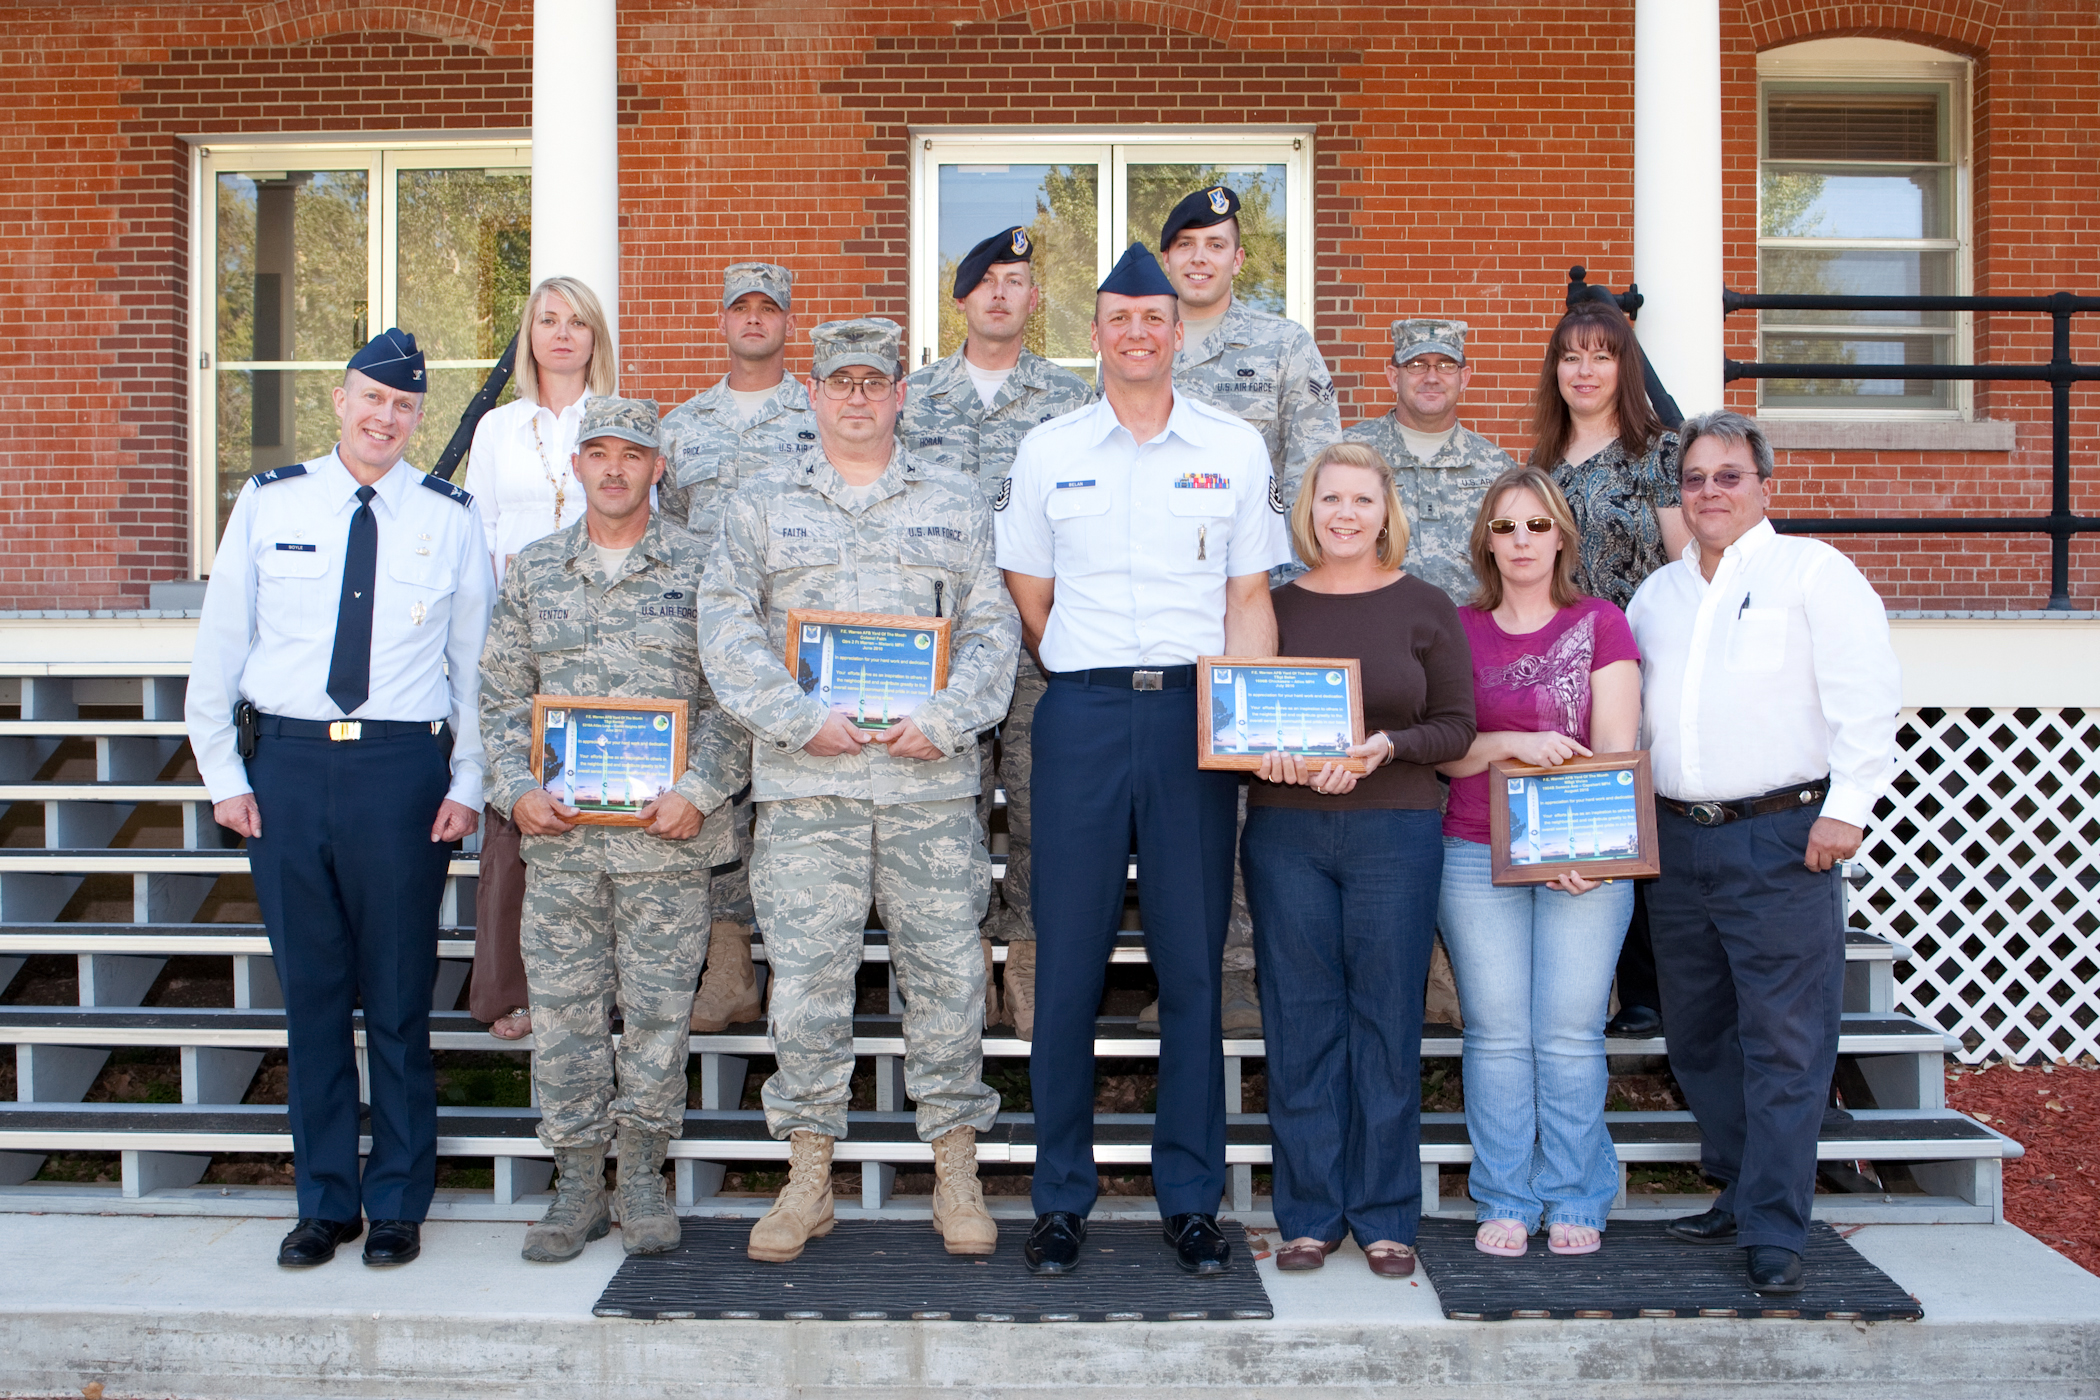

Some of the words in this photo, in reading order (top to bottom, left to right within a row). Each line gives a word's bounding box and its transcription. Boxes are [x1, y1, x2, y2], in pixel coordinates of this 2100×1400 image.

[1217, 382, 1232, 392] U.S.
[1234, 382, 1247, 392] AIR
[1249, 382, 1273, 392] FORCE
[779, 443, 794, 452] U.S.
[1461, 479, 1478, 487] U.S.
[1480, 478, 1493, 486] AR
[782, 528, 807, 538] FAITH
[908, 527, 925, 537] U.S.
[927, 527, 940, 537] AIR
[942, 528, 961, 541] FORCE
[642, 606, 656, 616] U.S.
[660, 606, 674, 616] AIR
[678, 607, 698, 619] FORC
